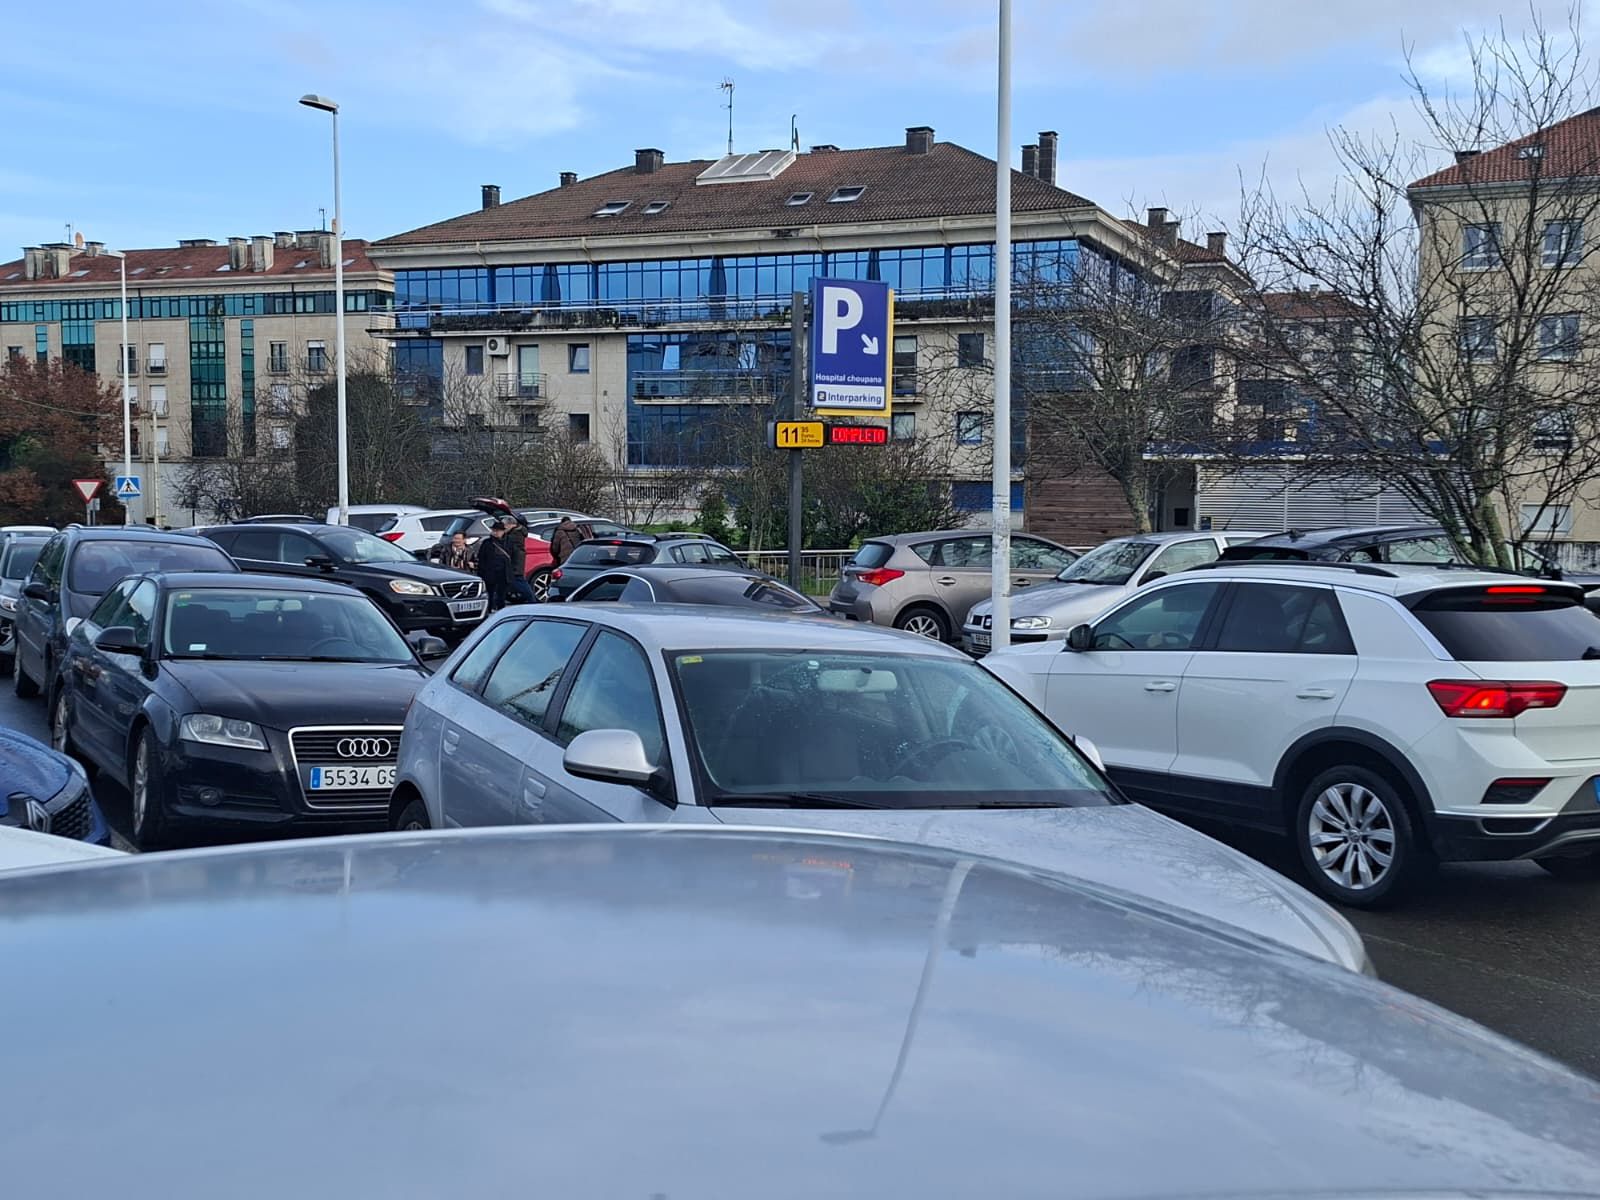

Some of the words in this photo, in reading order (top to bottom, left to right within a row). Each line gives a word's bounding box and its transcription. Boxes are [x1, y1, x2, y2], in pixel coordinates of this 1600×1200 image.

[822, 286, 863, 354] P
[815, 373, 846, 383] Hospital
[847, 375, 882, 384] choupana
[828, 392, 882, 405] Interparking
[782, 427, 798, 443] 11
[832, 427, 885, 443] COMPLETO
[324, 769, 370, 786] 5534
